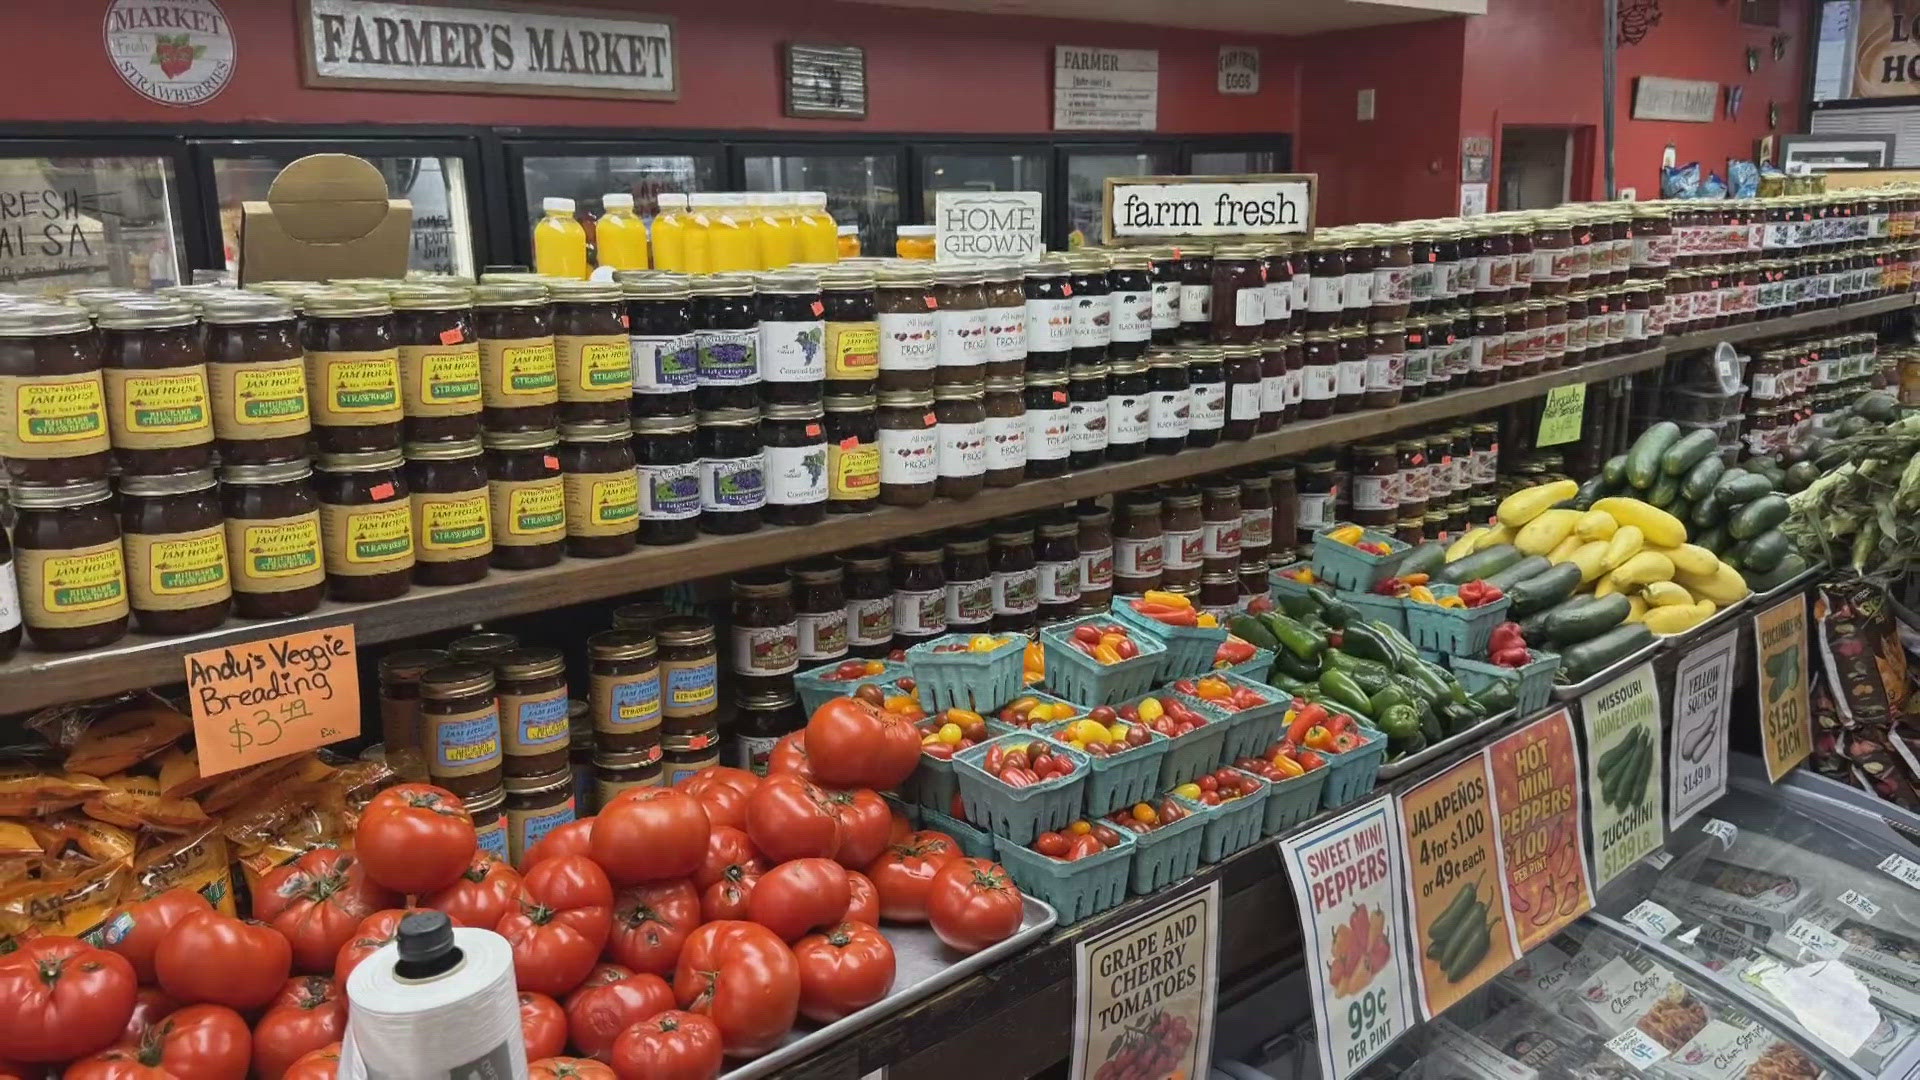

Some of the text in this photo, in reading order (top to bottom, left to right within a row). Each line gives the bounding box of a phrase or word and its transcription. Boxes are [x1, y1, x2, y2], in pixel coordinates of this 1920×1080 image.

[113, 6, 222, 34] MARKET
[319, 13, 667, 78] FARMER'S MARKET
[1064, 51, 1119, 72] FARMER
[119, 59, 230, 101] STRAWBERRIES
[945, 207, 1036, 233] HOME
[1123, 192, 1299, 228] farm fresh
[944, 234, 1035, 253] GROWN
[55, 566, 80, 578] JAM
[162, 549, 185, 561] JAM
[190, 634, 351, 688] Andy's Veggie
[1688, 664, 1720, 697] YELLOW
[200, 670, 333, 717] Breading
[1597, 680, 1642, 715] MISSOURI
[1687, 684, 1718, 717] SQUASH
[1593, 692, 1655, 743] HOMEGROWN
[1514, 736, 1549, 777] HOT
[1777, 727, 1801, 761] EACH
[1411, 776, 1485, 839] JALAPEÑOS
[1517, 766, 1553, 804] MINI
[1500, 784, 1573, 840] PEPPERS
[1602, 800, 1654, 852] ZUCCHINI
[1306, 821, 1385, 879] SWEET MINI
[1420, 808, 1485, 867] 4 for $1.00
[1503, 826, 1549, 872] $1.00
[1603, 834, 1635, 881] $1.99
[1311, 848, 1389, 915] PEPPERS
[1423, 881, 1435, 898] or
[1462, 846, 1487, 875] each
[1513, 855, 1549, 884] PER PINT
[1099, 913, 1198, 979] GRAPE AND
[1110, 943, 1188, 1000] CHERRY
[1537, 971, 1564, 992] Clam
[1610, 972, 1661, 1016] Clam Strips
[1098, 965, 1198, 1033] TOMATOES
[1347, 986, 1389, 1041] 99¢
[1347, 1018, 1393, 1070] PER PINT
[1713, 1023, 1766, 1071] Clam Strips
